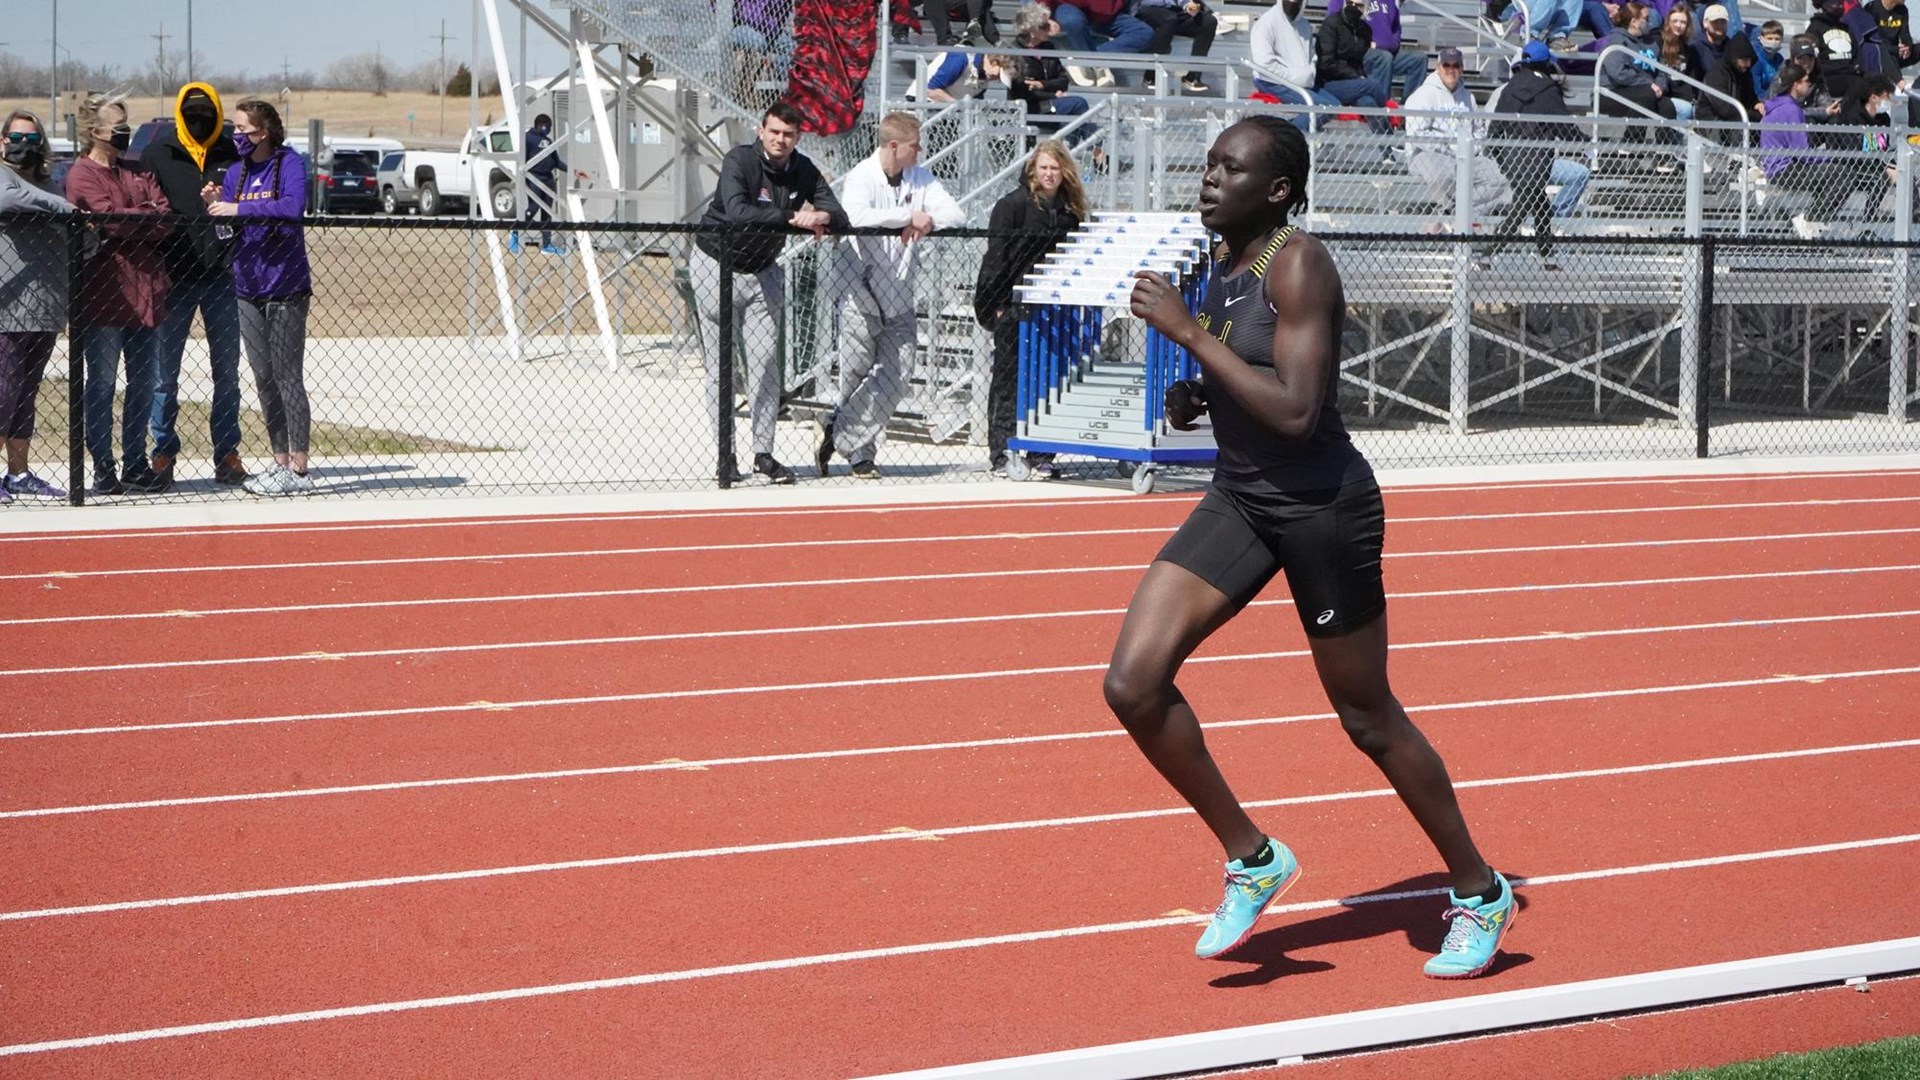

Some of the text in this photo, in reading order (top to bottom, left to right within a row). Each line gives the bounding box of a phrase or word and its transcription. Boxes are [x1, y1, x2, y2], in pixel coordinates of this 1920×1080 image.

[1110, 398, 1130, 406] UCS
[1101, 410, 1120, 418] UCS
[1089, 421, 1109, 429] UCS
[1079, 432, 1098, 440] UCS
